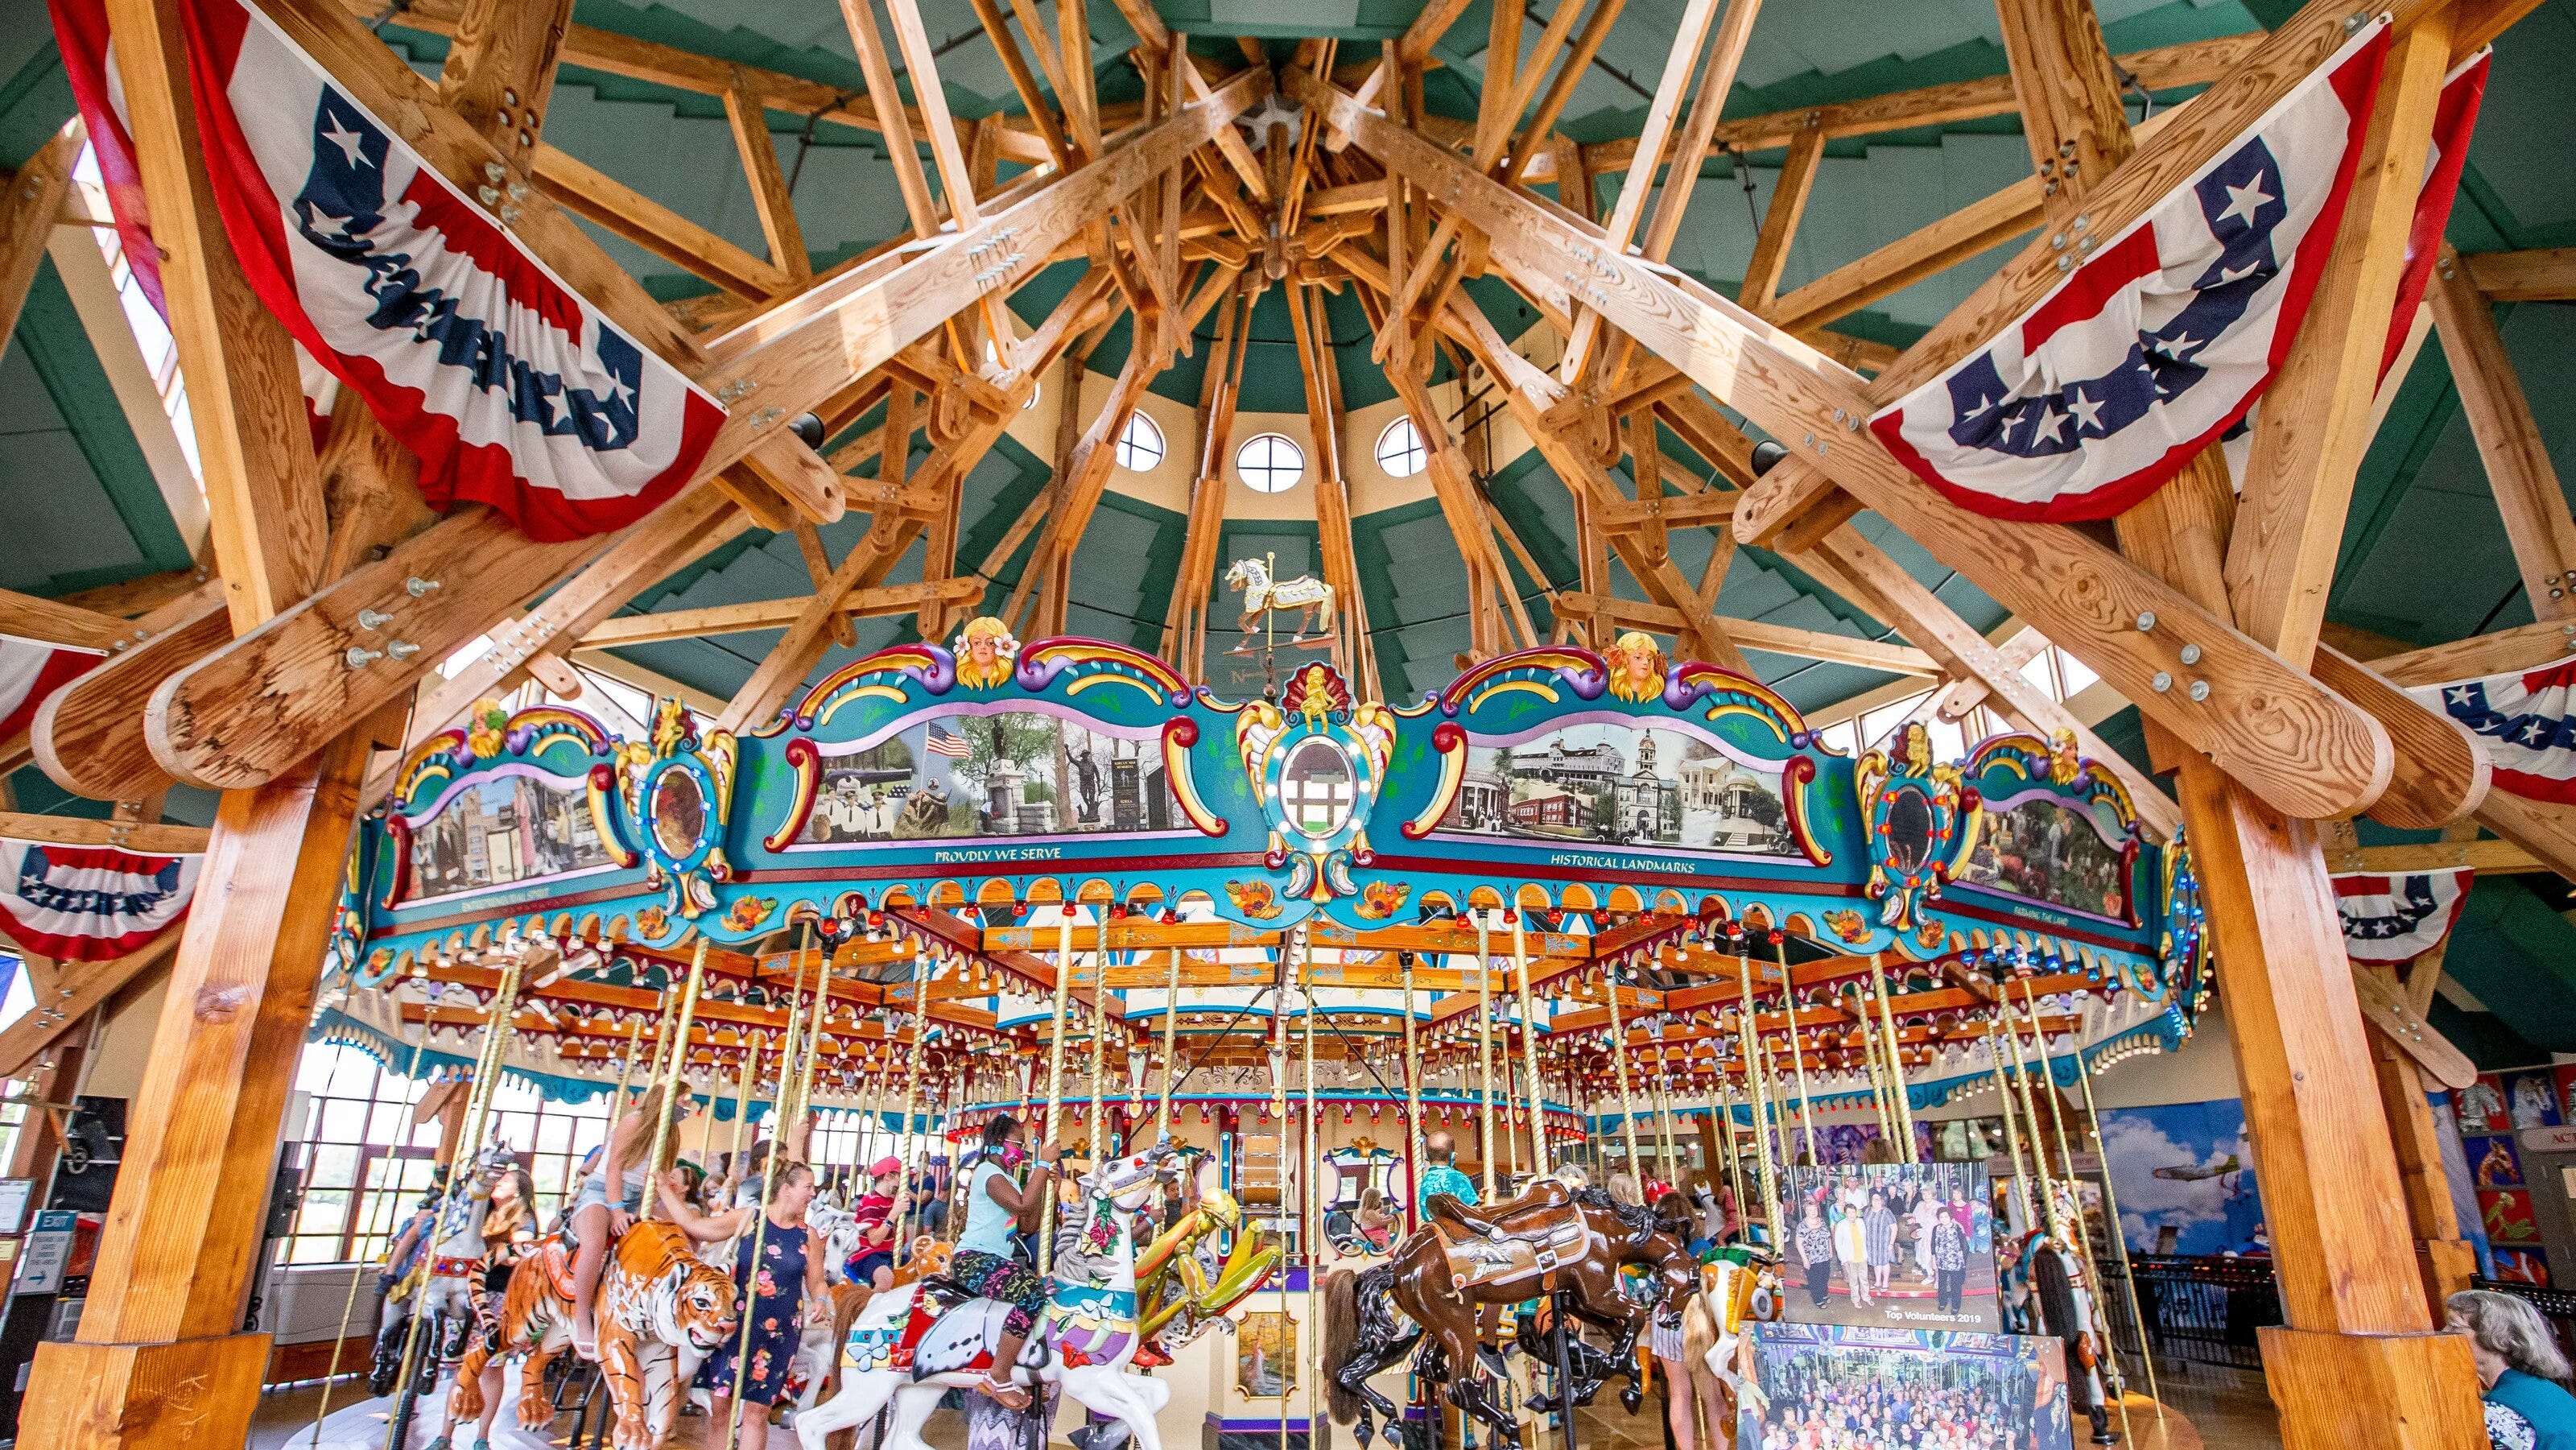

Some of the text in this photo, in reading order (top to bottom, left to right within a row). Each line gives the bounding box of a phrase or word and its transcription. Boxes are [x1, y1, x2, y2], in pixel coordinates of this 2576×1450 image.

[935, 847, 1061, 862] PROUDLY WE SERVE
[1550, 854, 1695, 874] HISTORICAL LANDMARKS
[41, 1215, 71, 1228] EXIT
[1471, 1262, 1513, 1281] BRONCOS
[1885, 1310, 1981, 1324] Top Volunteers 2019
